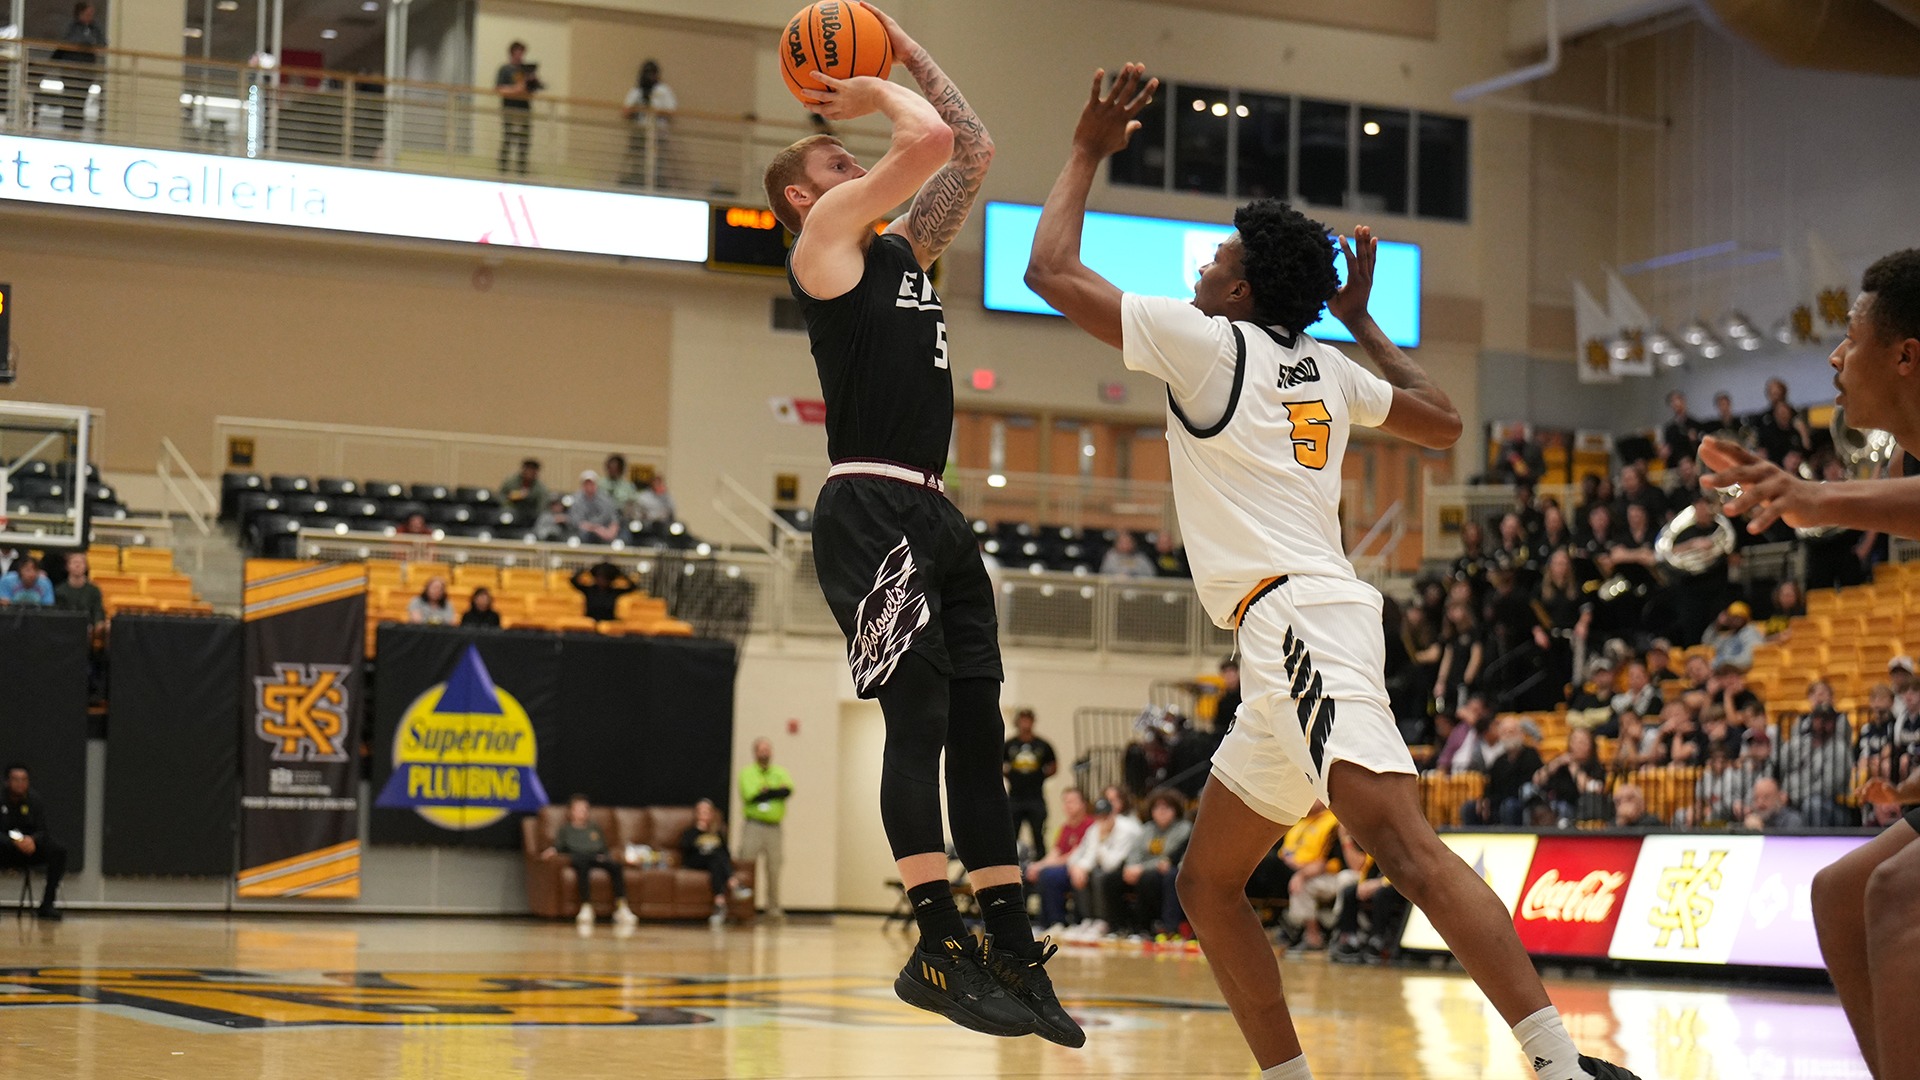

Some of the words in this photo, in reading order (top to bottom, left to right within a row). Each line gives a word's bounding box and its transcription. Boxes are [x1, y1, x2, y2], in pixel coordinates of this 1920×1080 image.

[788, 17, 807, 68] NCAA
[819, 1, 842, 68] Wilson
[50, 157, 101, 196] at
[123, 159, 327, 215] Galleria
[912, 169, 967, 249] Family
[933, 321, 949, 370] 5
[1281, 399, 1332, 470] 5
[407, 717, 525, 761] Superior
[407, 764, 521, 800] PLUMBING
